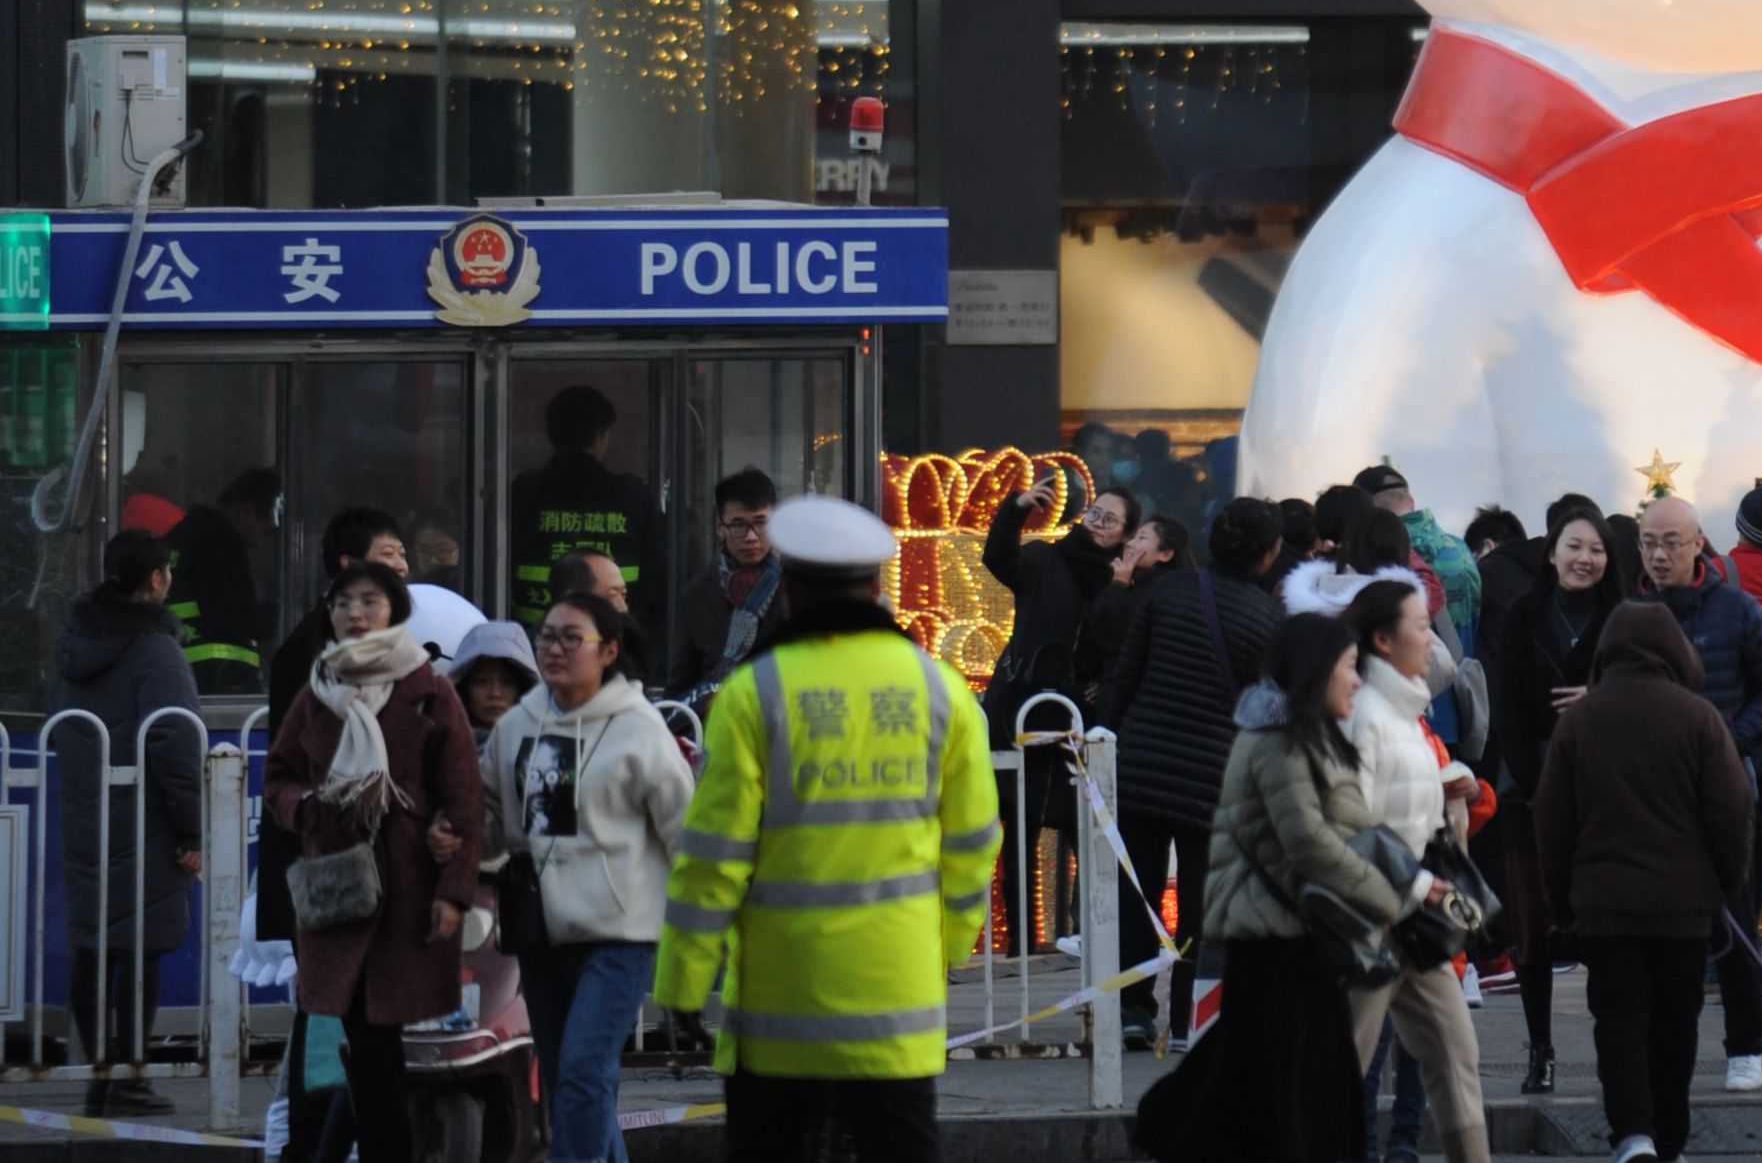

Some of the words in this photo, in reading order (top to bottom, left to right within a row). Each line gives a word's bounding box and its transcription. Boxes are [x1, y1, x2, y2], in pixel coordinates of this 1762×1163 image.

[135, 239, 344, 303] 公安
[640, 240, 878, 295] POLICE
[540, 511, 627, 533] 消防疏散
